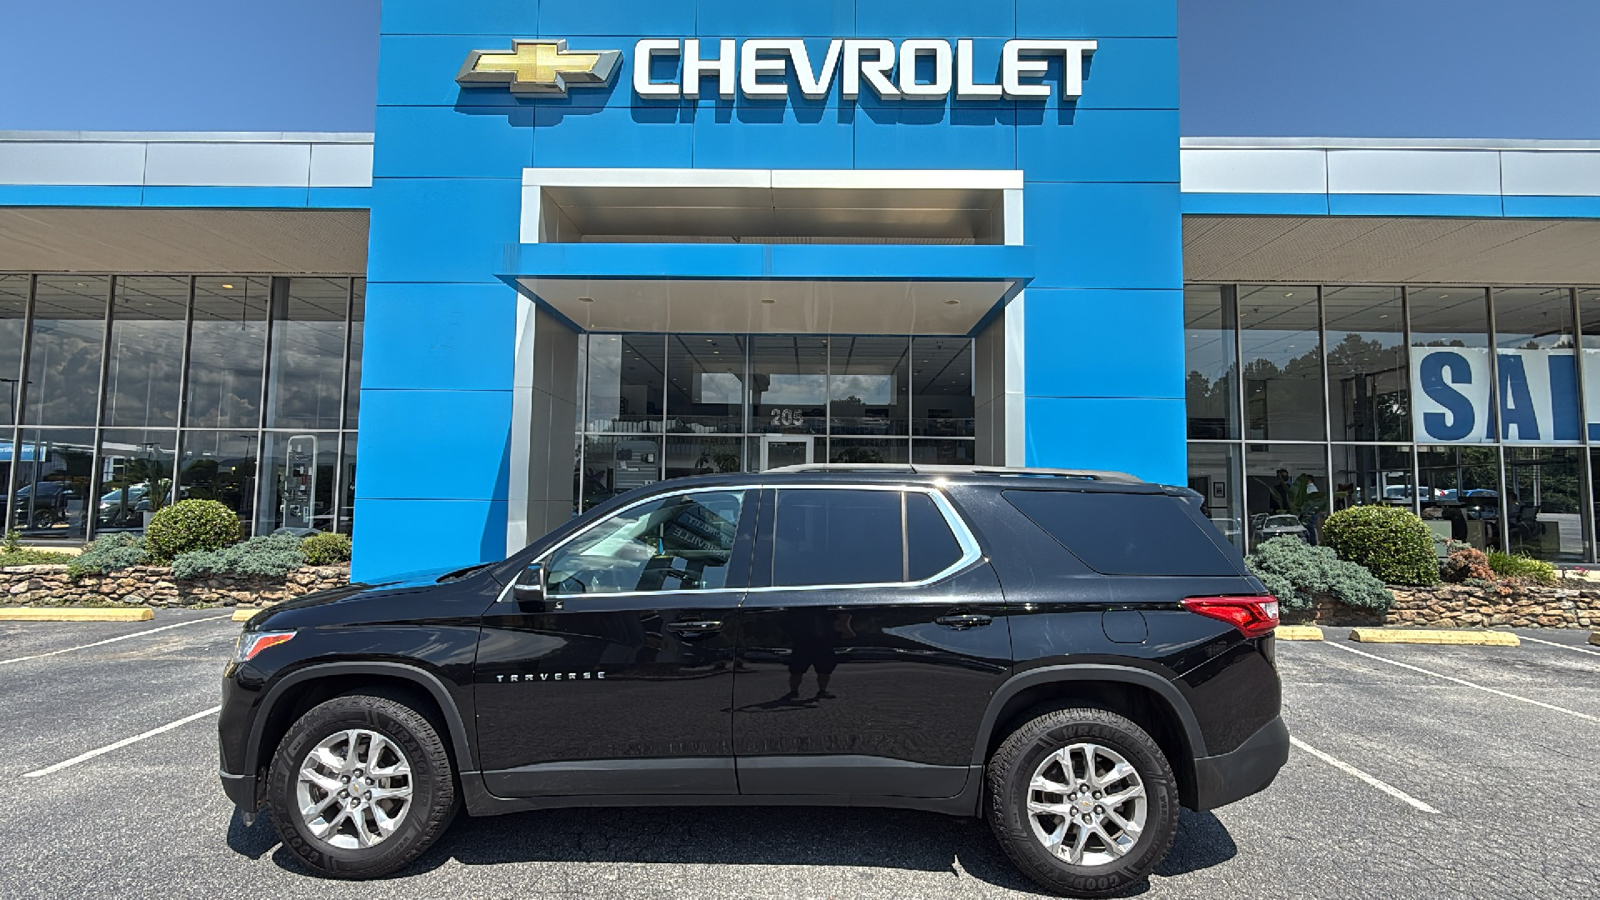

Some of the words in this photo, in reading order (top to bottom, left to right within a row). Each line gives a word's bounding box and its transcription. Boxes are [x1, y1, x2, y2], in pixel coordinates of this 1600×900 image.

[633, 38, 1098, 100] CHEVROLET
[770, 408, 804, 426] 205
[496, 671, 606, 682] TRAVERSE
